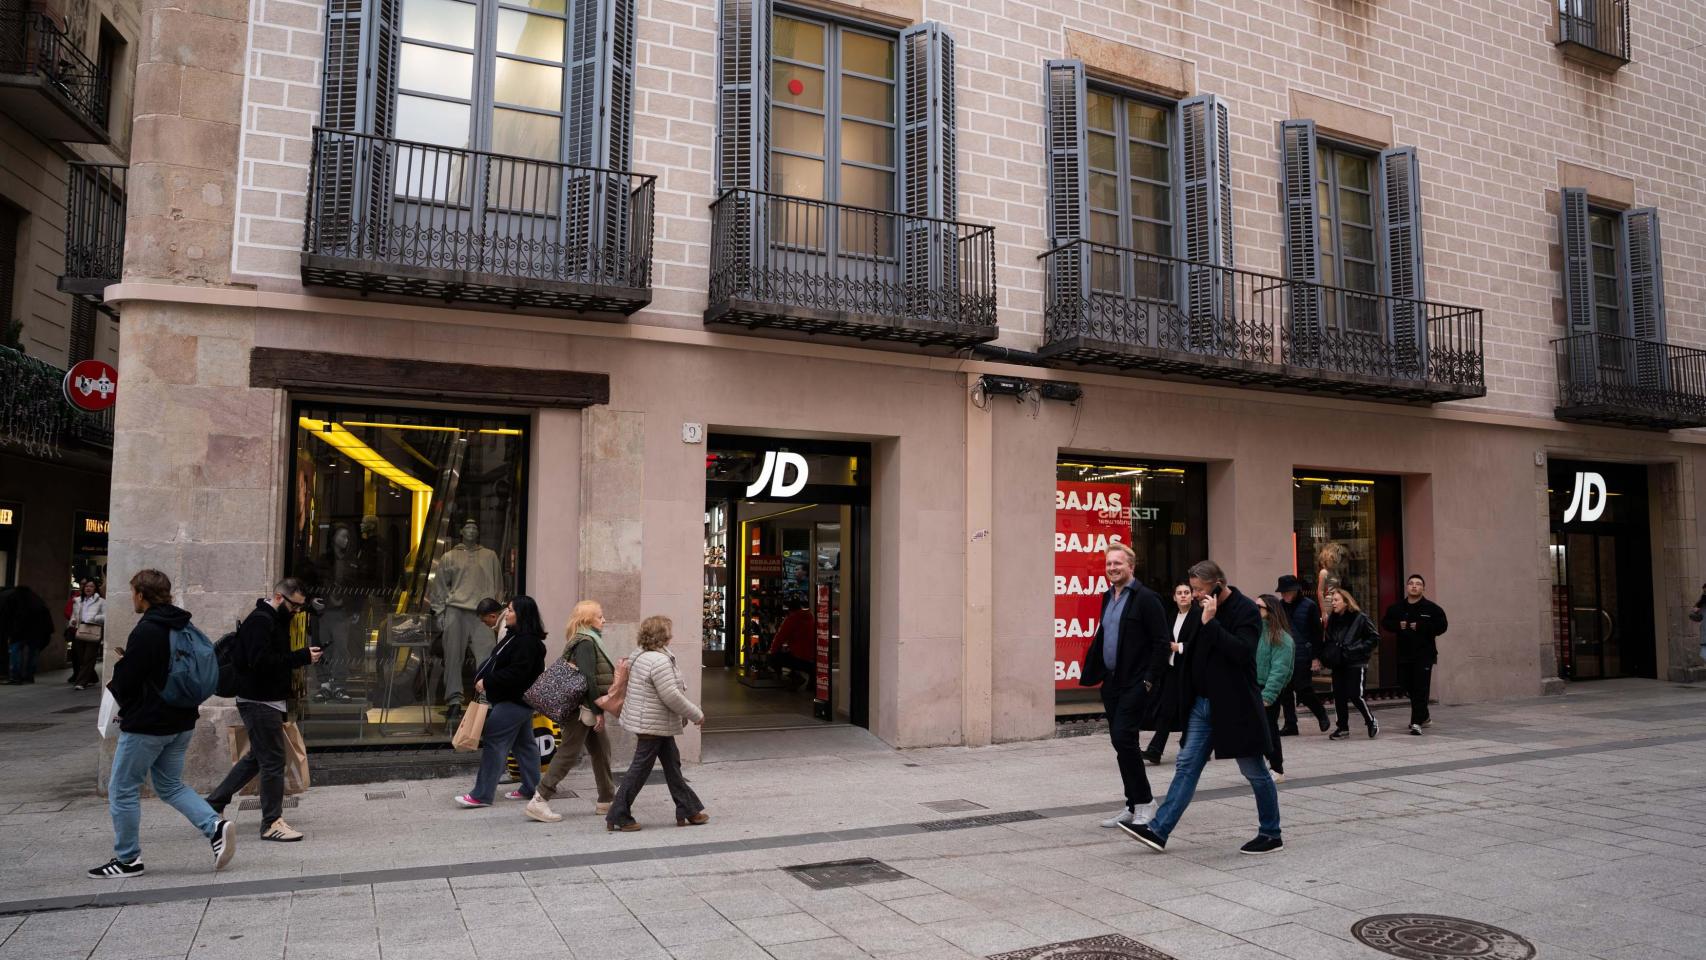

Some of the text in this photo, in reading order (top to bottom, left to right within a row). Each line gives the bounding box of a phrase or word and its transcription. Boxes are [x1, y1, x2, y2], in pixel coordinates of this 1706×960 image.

[689, 427, 696, 439] 9
[746, 451, 809, 497] JD
[1056, 490, 1122, 512] BAJAS
[1563, 472, 1607, 523] JD
[1055, 575, 1112, 595] BAJA
